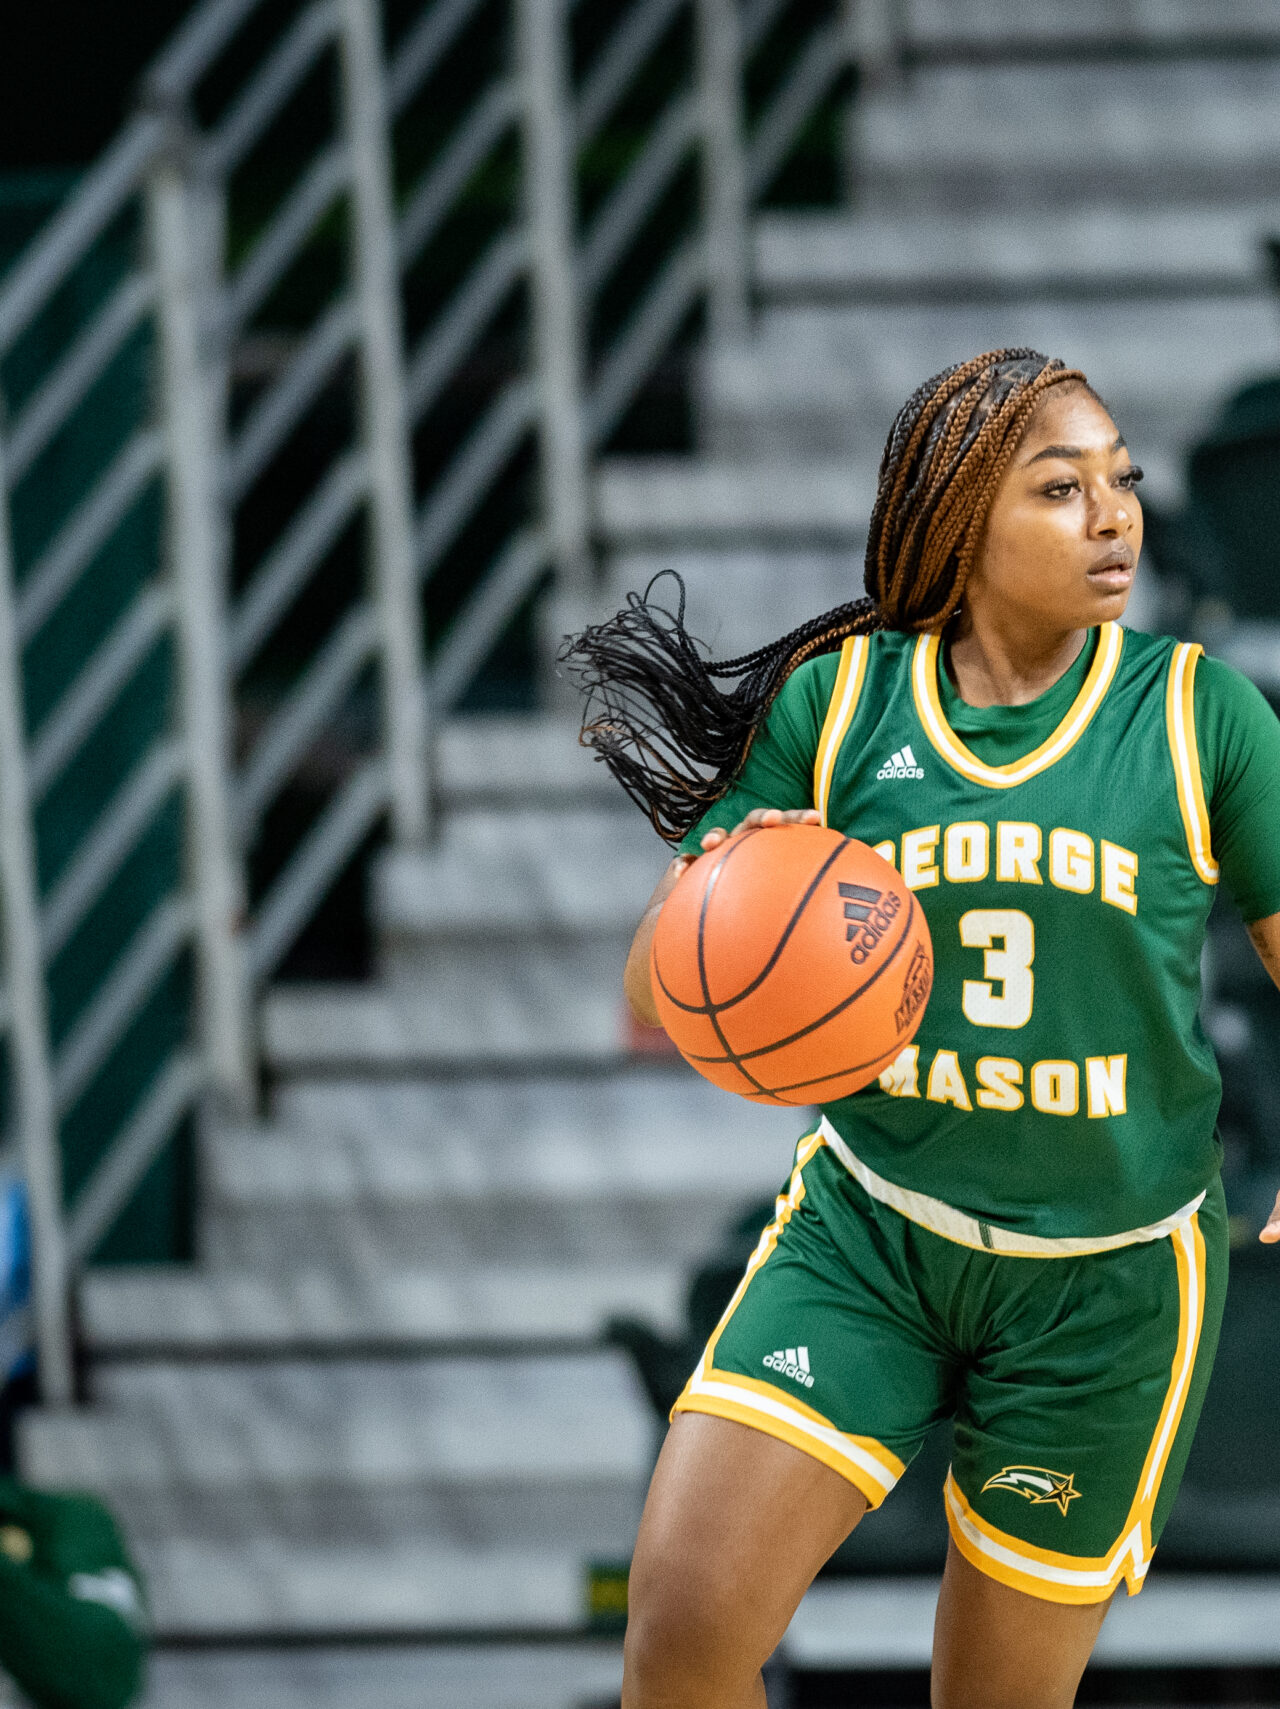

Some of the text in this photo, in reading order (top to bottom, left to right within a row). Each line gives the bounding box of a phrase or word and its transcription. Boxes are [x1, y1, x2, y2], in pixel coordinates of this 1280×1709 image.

[876, 765, 925, 780] adidas
[871, 820, 1138, 917] EORGE
[850, 890, 901, 966] adidas
[958, 908, 1035, 1030] 3
[762, 1355, 815, 1388] adidas
